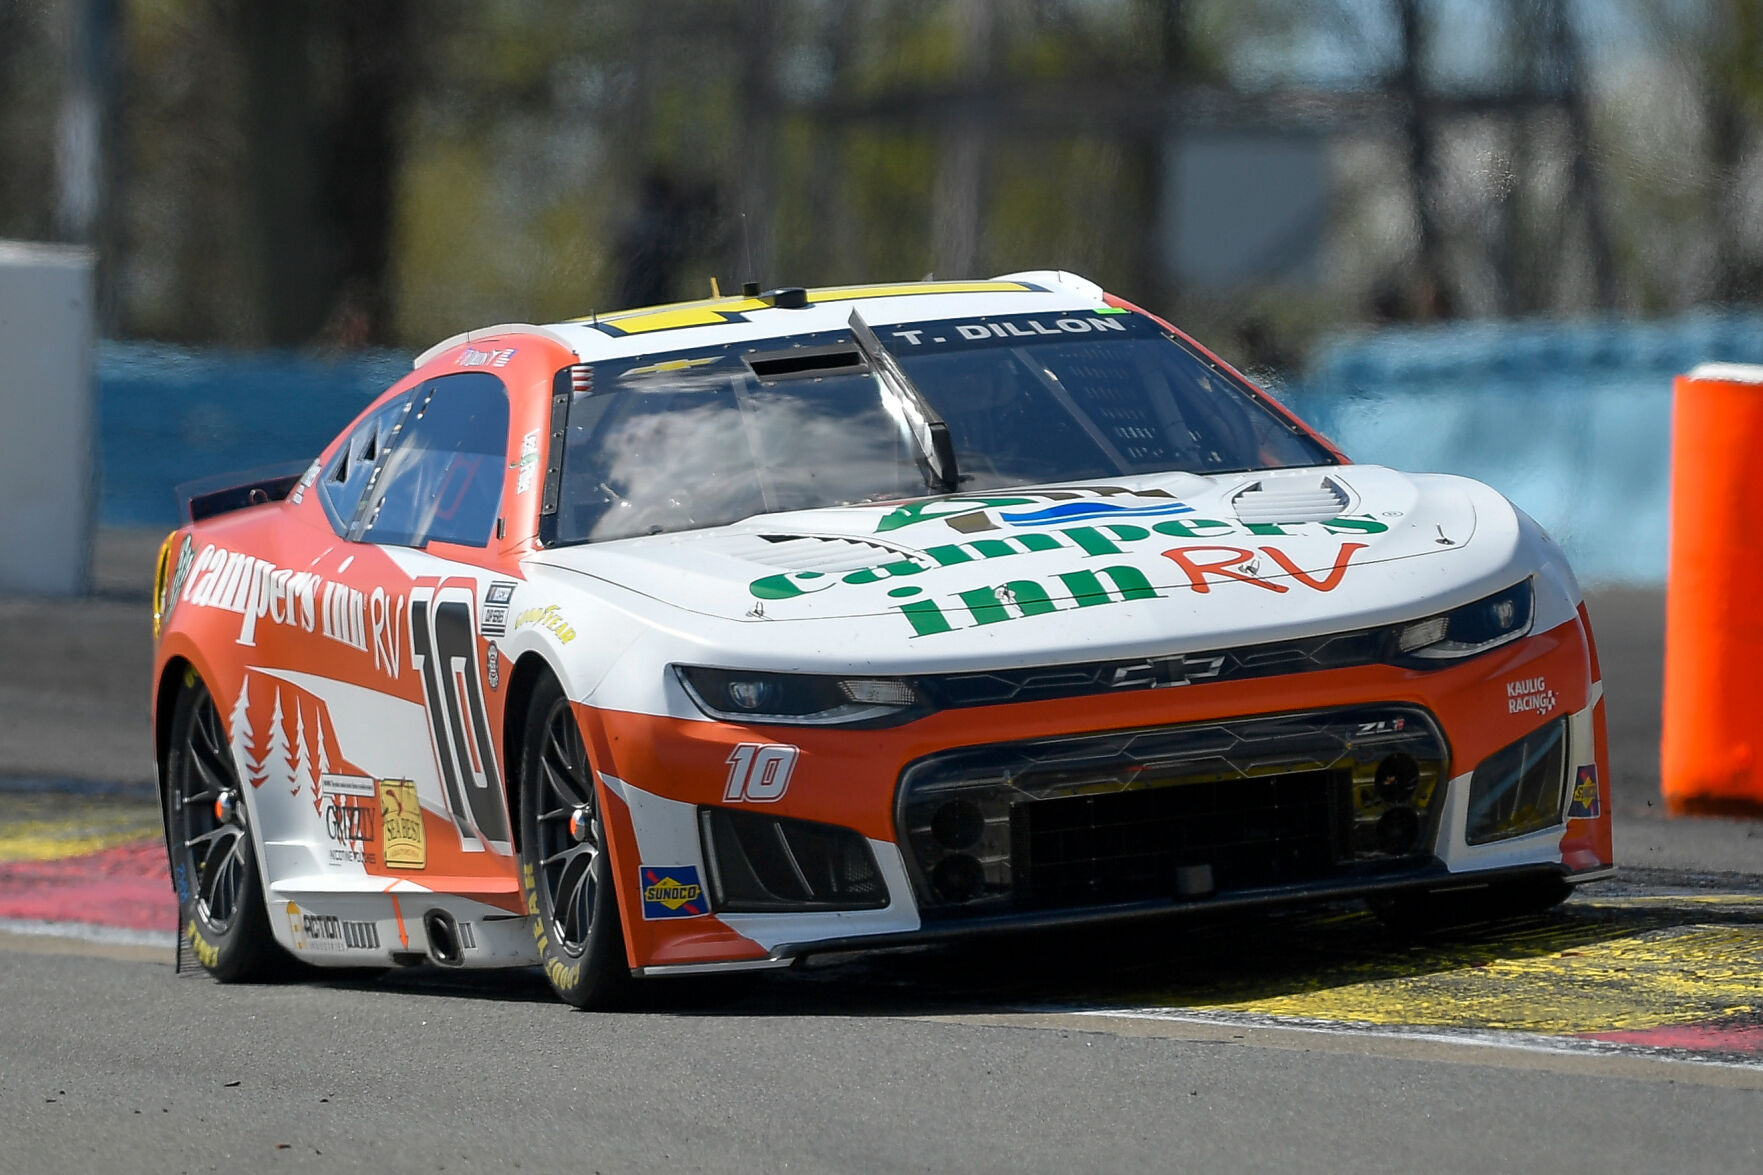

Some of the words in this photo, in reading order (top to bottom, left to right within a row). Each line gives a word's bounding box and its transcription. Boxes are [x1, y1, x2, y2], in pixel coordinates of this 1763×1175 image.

[892, 330, 947, 345] T.
[955, 317, 1127, 340] DILLON
[183, 543, 322, 647] campers
[323, 554, 369, 653] inn
[370, 585, 405, 681] RV
[887, 561, 1169, 639] inn
[1160, 542, 1371, 595] RV
[1506, 676, 1545, 697] KAULIG
[1508, 694, 1549, 713] RACING
[407, 576, 516, 857] 10
[722, 741, 800, 803] 10
[646, 884, 700, 902] SUNOCO
